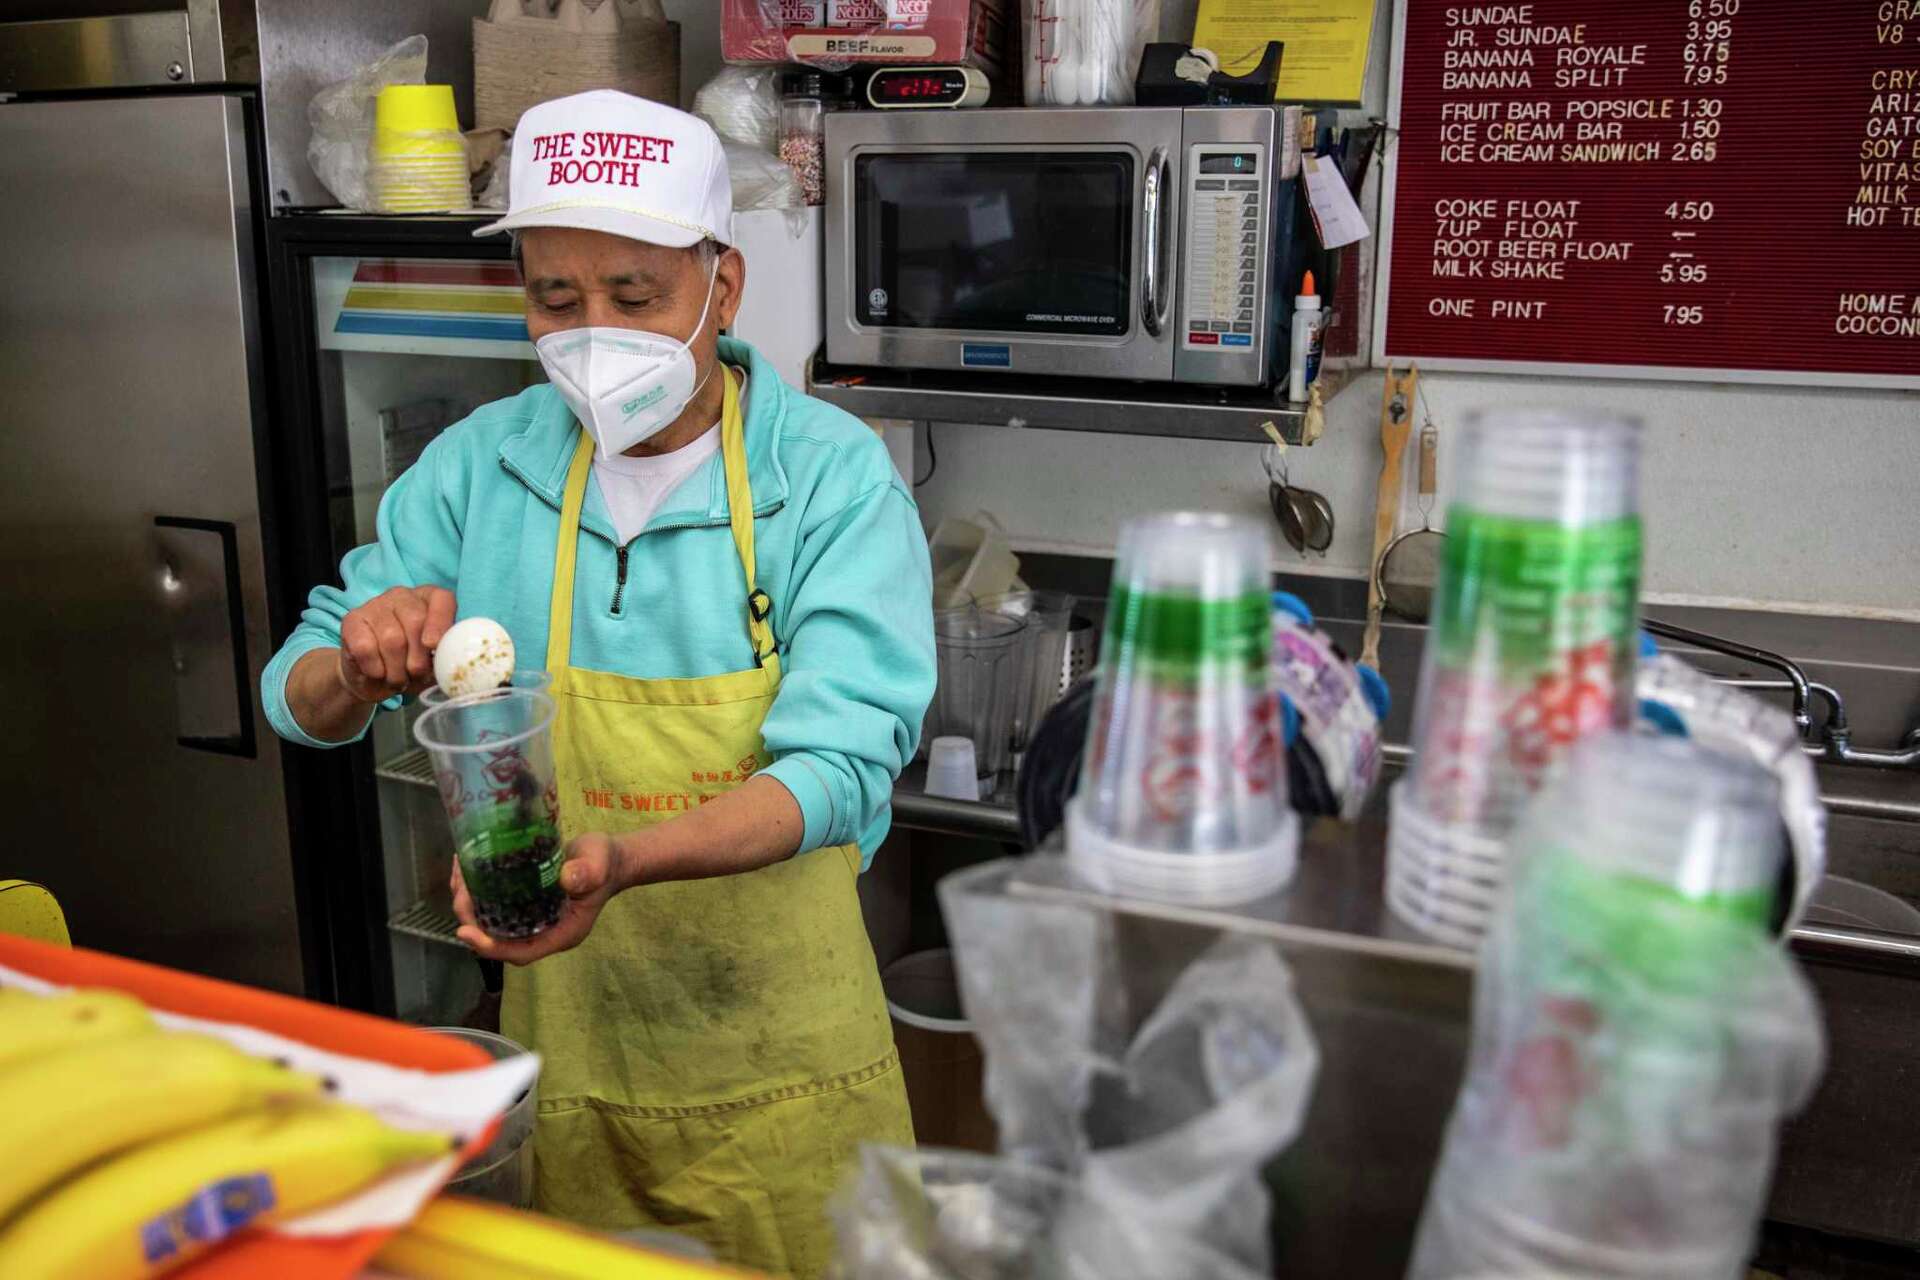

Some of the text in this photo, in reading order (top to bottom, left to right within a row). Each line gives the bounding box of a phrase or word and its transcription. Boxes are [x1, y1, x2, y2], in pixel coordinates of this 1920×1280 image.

[1445, 0, 1740, 26] SUNDAE 6.50
[1447, 20, 1732, 47] JR. SUNDAE 3.95
[1876, 24, 1904, 44] V8
[826, 40, 904, 54] BEEF FLAVOR
[1444, 42, 1731, 69] BANANA ROYALE 6.75
[1442, 65, 1728, 90] BANANA SPLIT 7.95
[1871, 69, 1920, 91] CRY
[1441, 99, 1723, 121] FRUIT BAR POPSICLE 1.30
[1440, 119, 1721, 142] ICE CREAM BAR 1.50
[533, 131, 674, 164] THE SWEET
[1440, 142, 1717, 163] ICE CREAM SANDWICH 2.65
[1860, 138, 1903, 160] SOY
[547, 160, 641, 187] BOOTH
[1855, 184, 1909, 205] MILK
[1435, 199, 1714, 220] COKE FLOAT 4.50
[1847, 206, 1891, 227] HOT
[1437, 219, 1578, 239] 7UP FLOAT
[1433, 239, 1633, 260] ROOT BEER FLOAT
[1432, 260, 1707, 283] MILK SHAKE 5.95
[1428, 298, 1703, 325] ONE PINT 7.95
[1840, 294, 1906, 314] HOME
[583, 788, 614, 809] THE
[620, 791, 690, 812] SWEET
